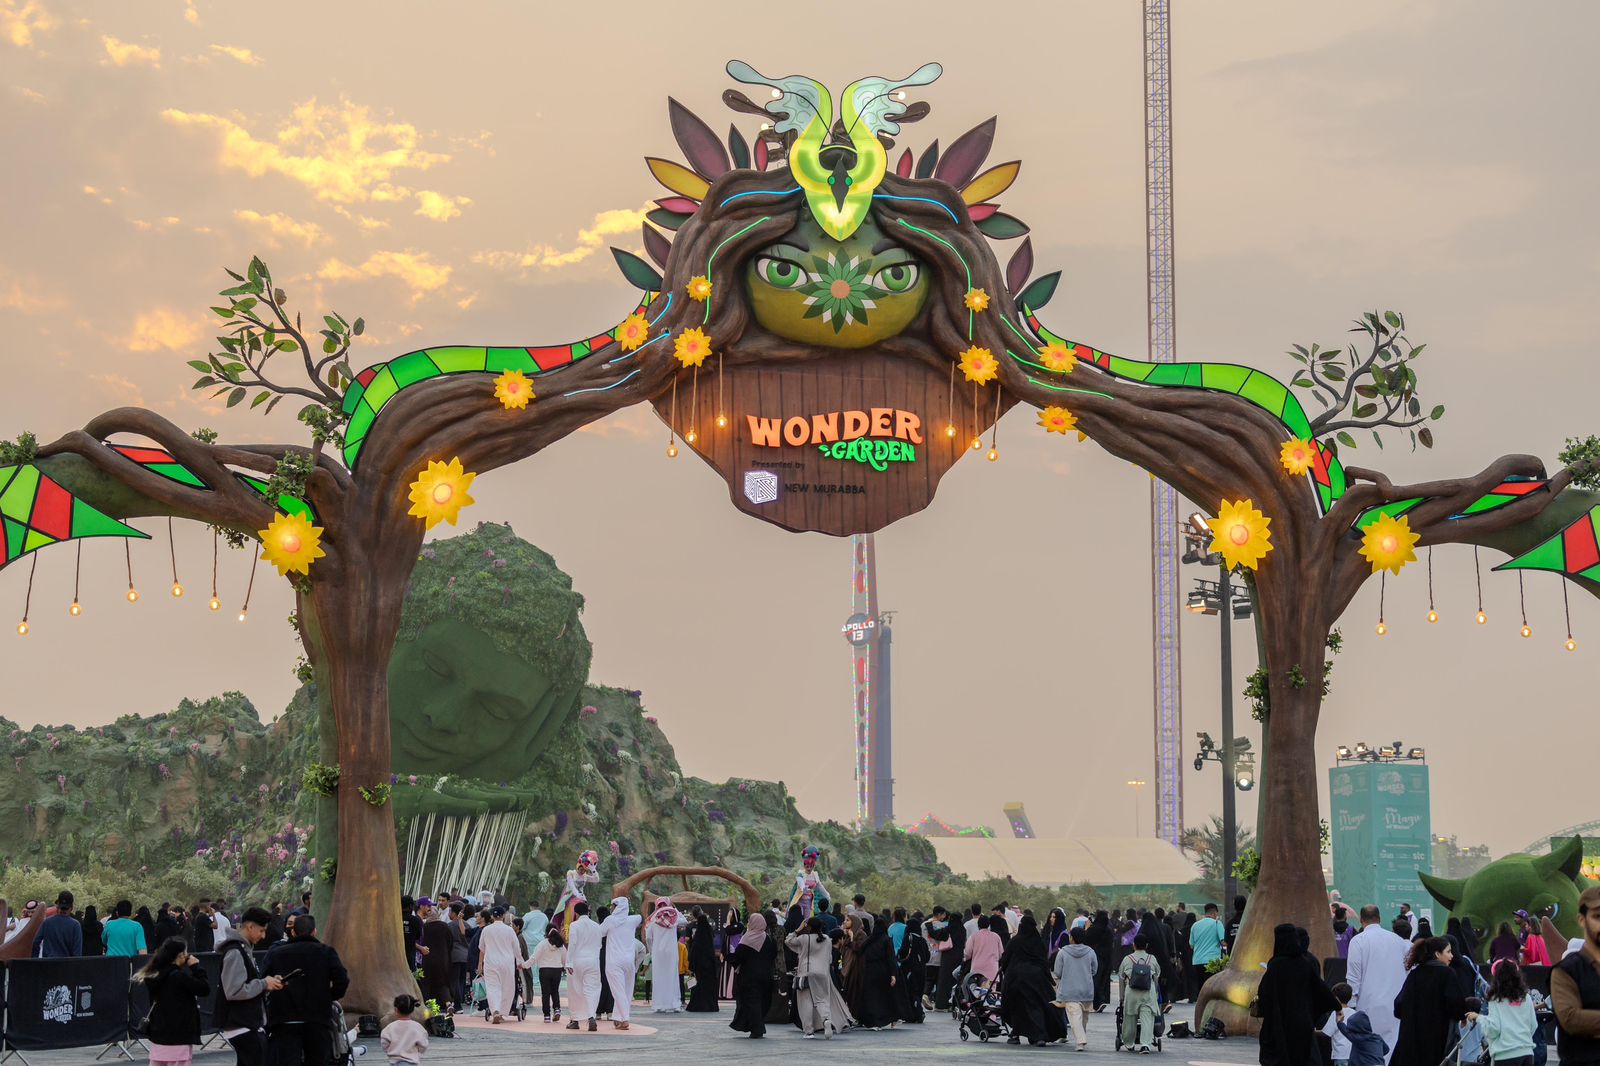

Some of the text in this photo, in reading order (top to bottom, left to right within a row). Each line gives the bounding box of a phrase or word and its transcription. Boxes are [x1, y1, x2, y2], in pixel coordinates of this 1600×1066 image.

[746, 407, 924, 448] WONDER
[830, 437, 916, 472] GARDEN
[752, 460, 805, 471] Presented by
[784, 483, 866, 495] NEW MURABBA
[842, 621, 874, 632] APOLLO
[852, 631, 863, 641] 13
[43, 1004, 73, 1020] WONDER
